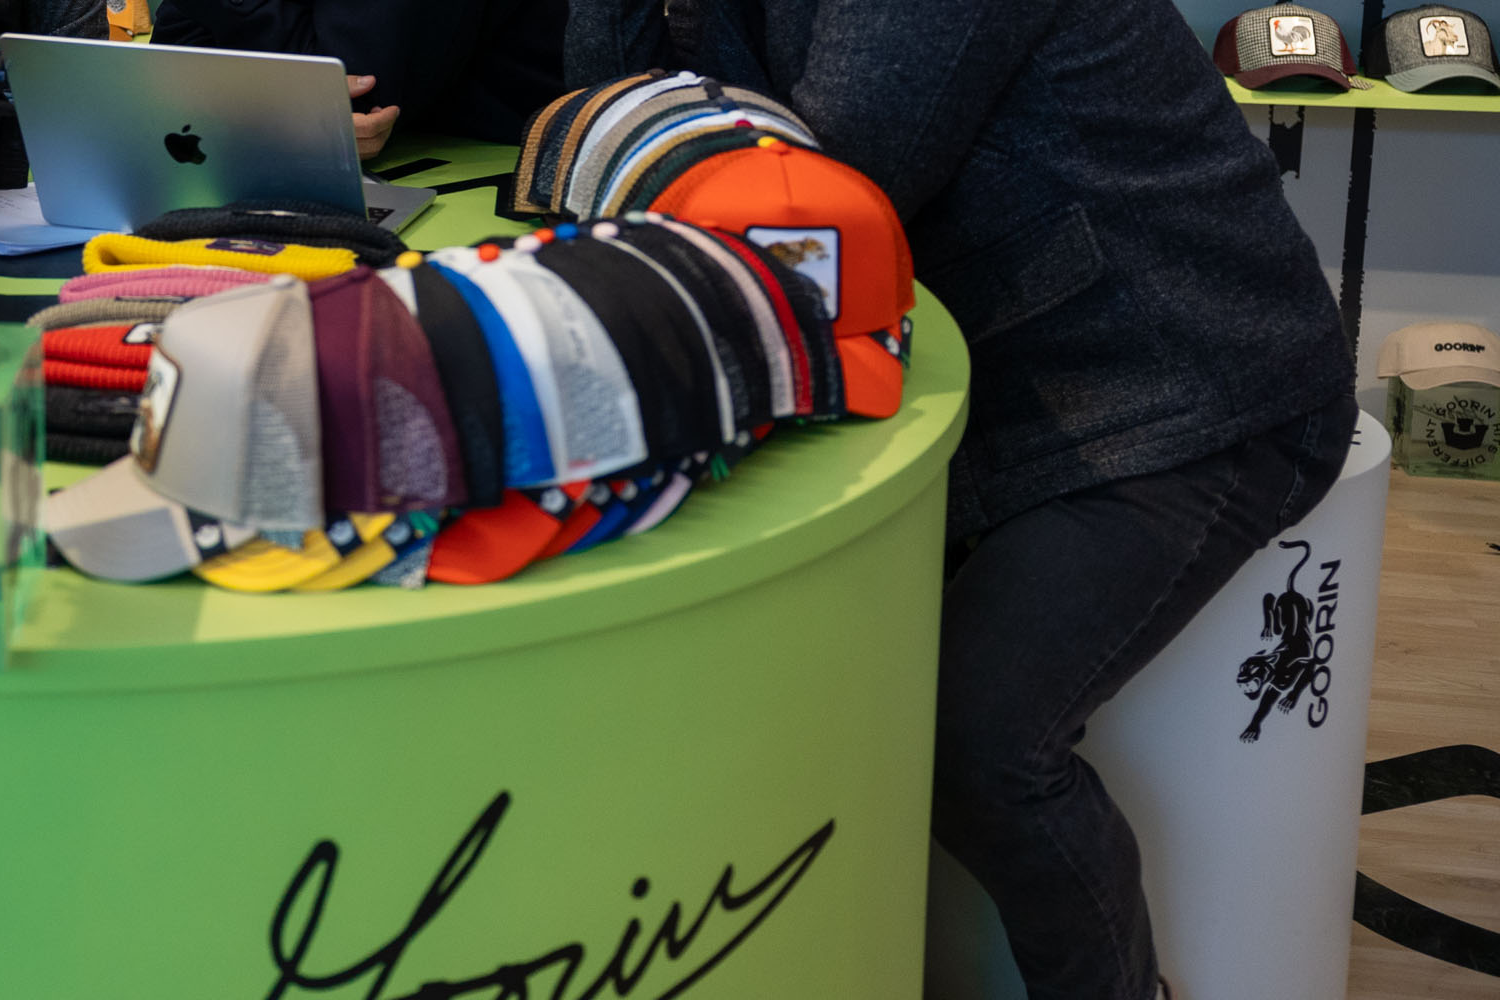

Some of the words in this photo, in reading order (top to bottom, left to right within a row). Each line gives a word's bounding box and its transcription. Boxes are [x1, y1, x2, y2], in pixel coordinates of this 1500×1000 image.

[1434, 343, 1481, 353] GOORIN
[1436, 399, 1496, 419] GOORIN
[1426, 419, 1486, 467] DIFFERENT
[1307, 559, 1341, 728] GOORIN
